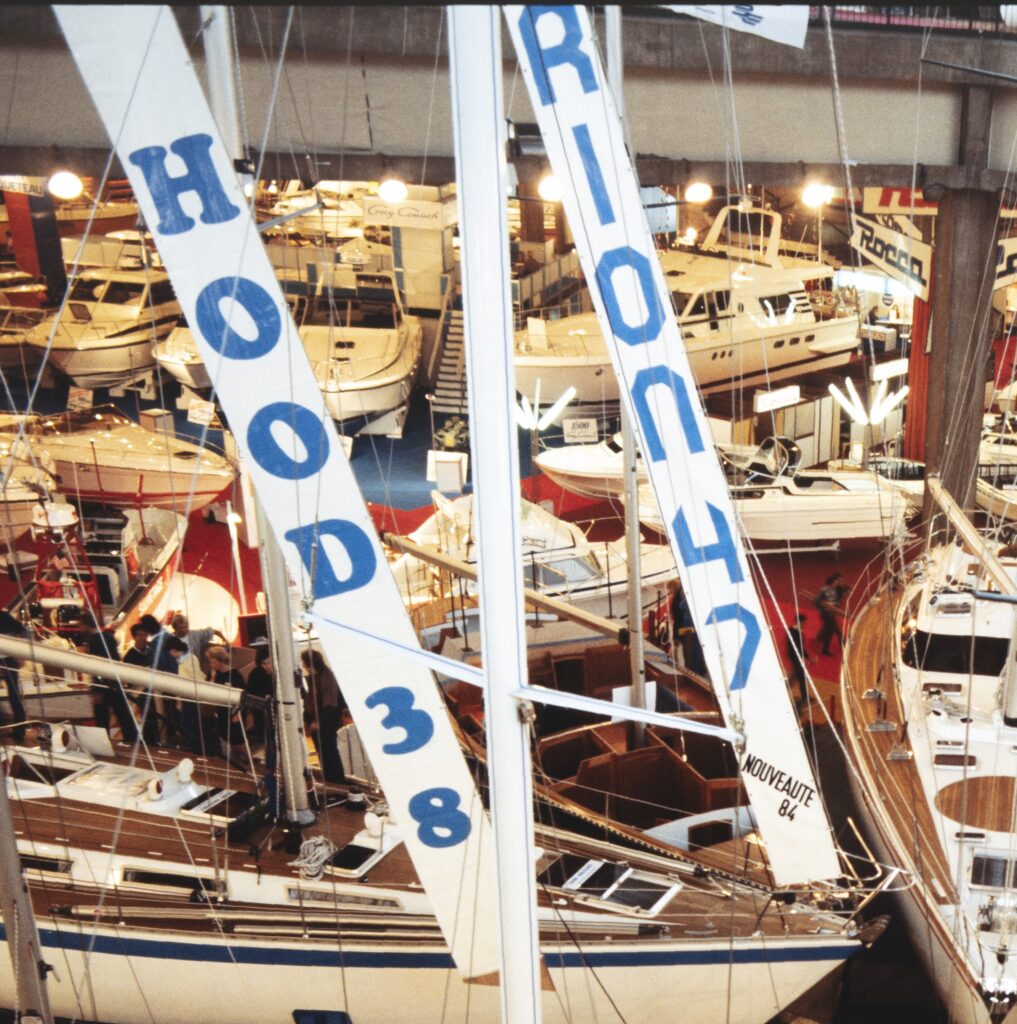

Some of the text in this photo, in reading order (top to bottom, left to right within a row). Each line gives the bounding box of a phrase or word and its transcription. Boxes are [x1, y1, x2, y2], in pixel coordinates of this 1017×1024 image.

[128, 133, 472, 849] HOOD 38
[742, 753, 817, 809] NOUVEAUTE
[778, 799, 799, 822] 84
